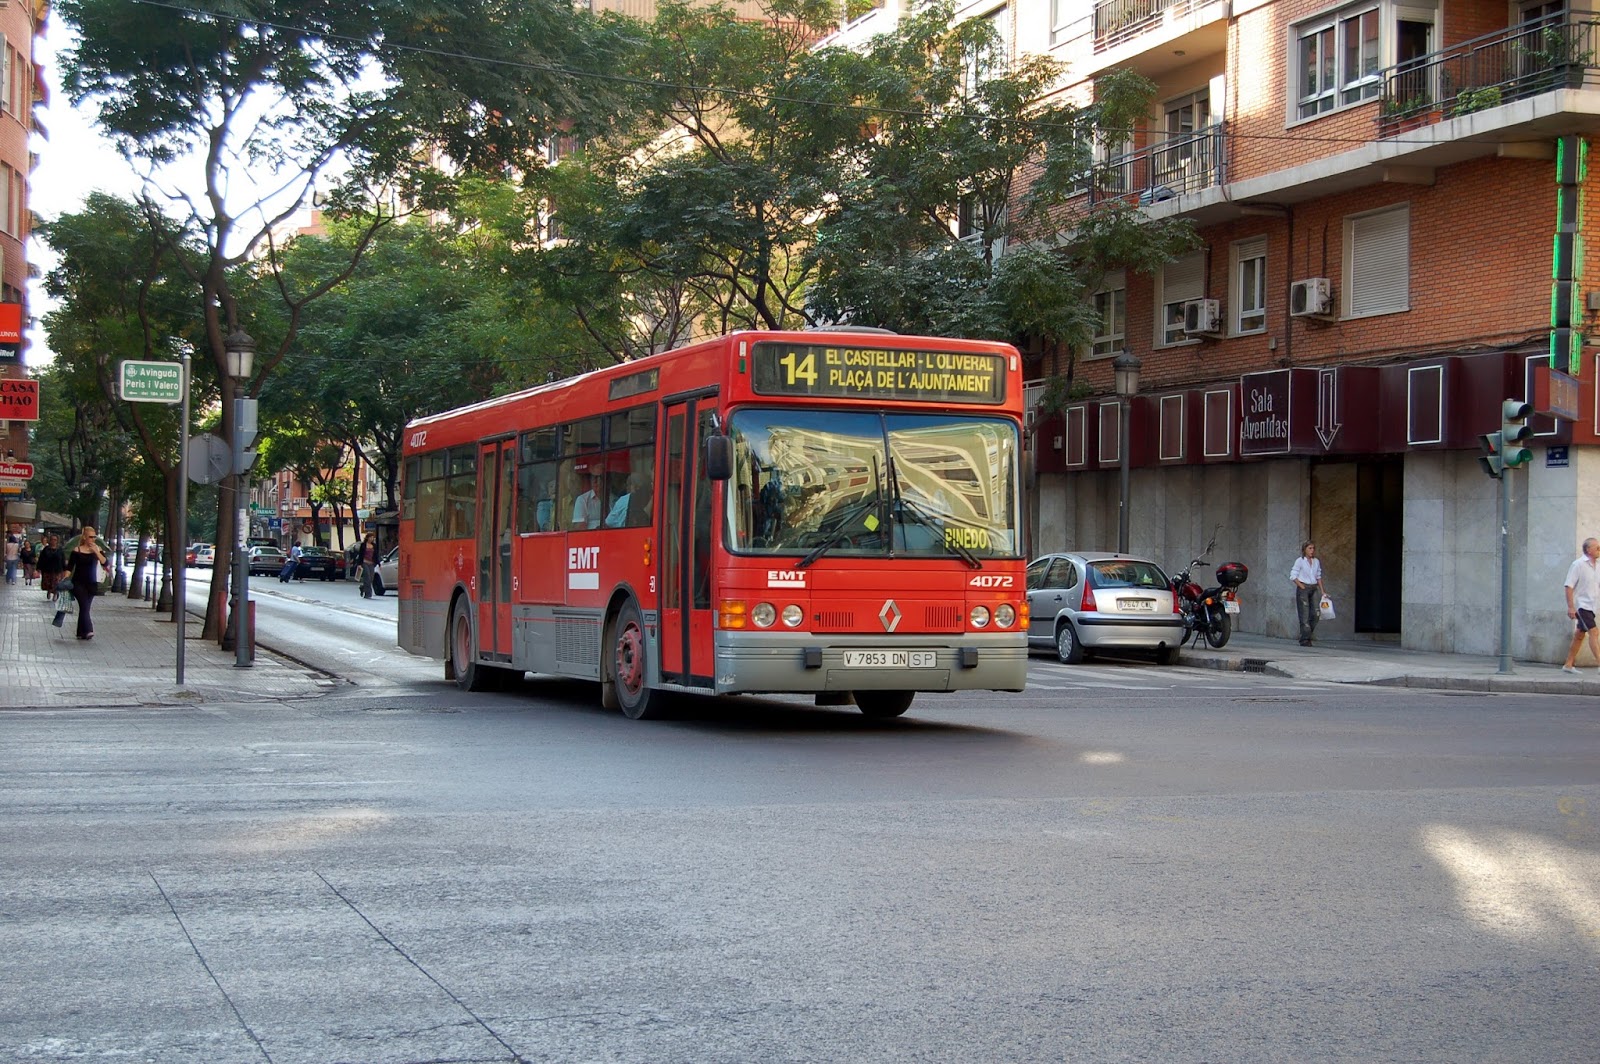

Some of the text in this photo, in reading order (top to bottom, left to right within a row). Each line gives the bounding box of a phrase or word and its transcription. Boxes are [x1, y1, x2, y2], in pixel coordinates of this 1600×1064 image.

[826, 349, 842, 365] EL
[844, 349, 916, 368] CASTELLAR
[140, 368, 178, 379] Avinguda
[780, 352, 818, 386] 14
[0, 383, 35, 393] CASA
[125, 379, 179, 390] Peris i Valero
[829, 369, 874, 391] PLAÇA
[877, 371, 895, 388] DE
[1250, 387, 1273, 413] Sala
[1242, 414, 1288, 440] Avenidas
[410, 431, 427, 448] 4072
[945, 528, 988, 550] PINEDO
[568, 546, 600, 570] EMT
[767, 570, 807, 580] EMT
[969, 575, 1014, 588] 4072
[892, 653, 907, 665] DN
